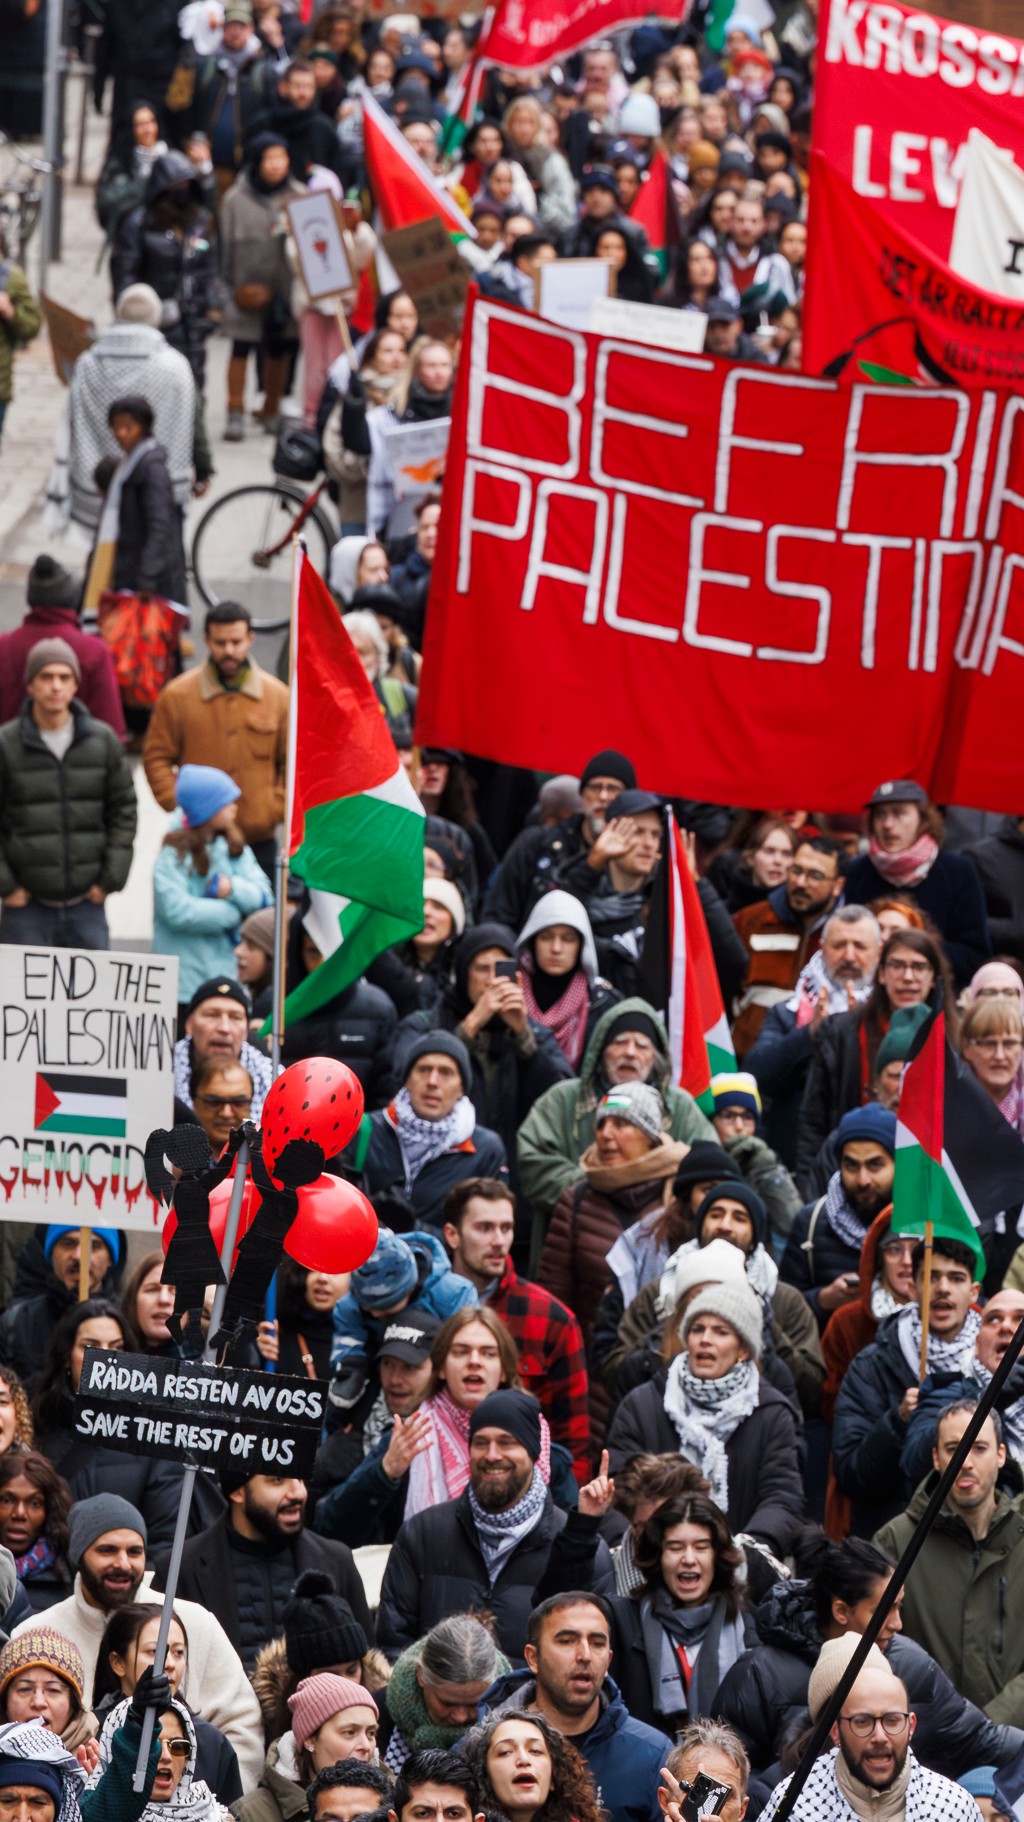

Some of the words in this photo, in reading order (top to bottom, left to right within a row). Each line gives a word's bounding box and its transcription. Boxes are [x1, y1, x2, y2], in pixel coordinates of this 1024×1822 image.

[853, 124, 1014, 208] LEV
[24, 952, 97, 1002] END
[109, 961, 166, 1004] THE
[2, 1004, 178, 1072] PALESTINIAN
[0, 1135, 154, 1209] GENOCID
[88, 1357, 159, 1396] RÄDDA
[162, 1374, 240, 1406] RESTEN
[242, 1384, 277, 1411] AV
[276, 1388, 323, 1420] OSS
[75, 1408, 129, 1439] SAVE
[133, 1416, 172, 1445] THE
[175, 1422, 228, 1452] REST
[229, 1431, 258, 1460] OF
[261, 1438, 296, 1466] US
